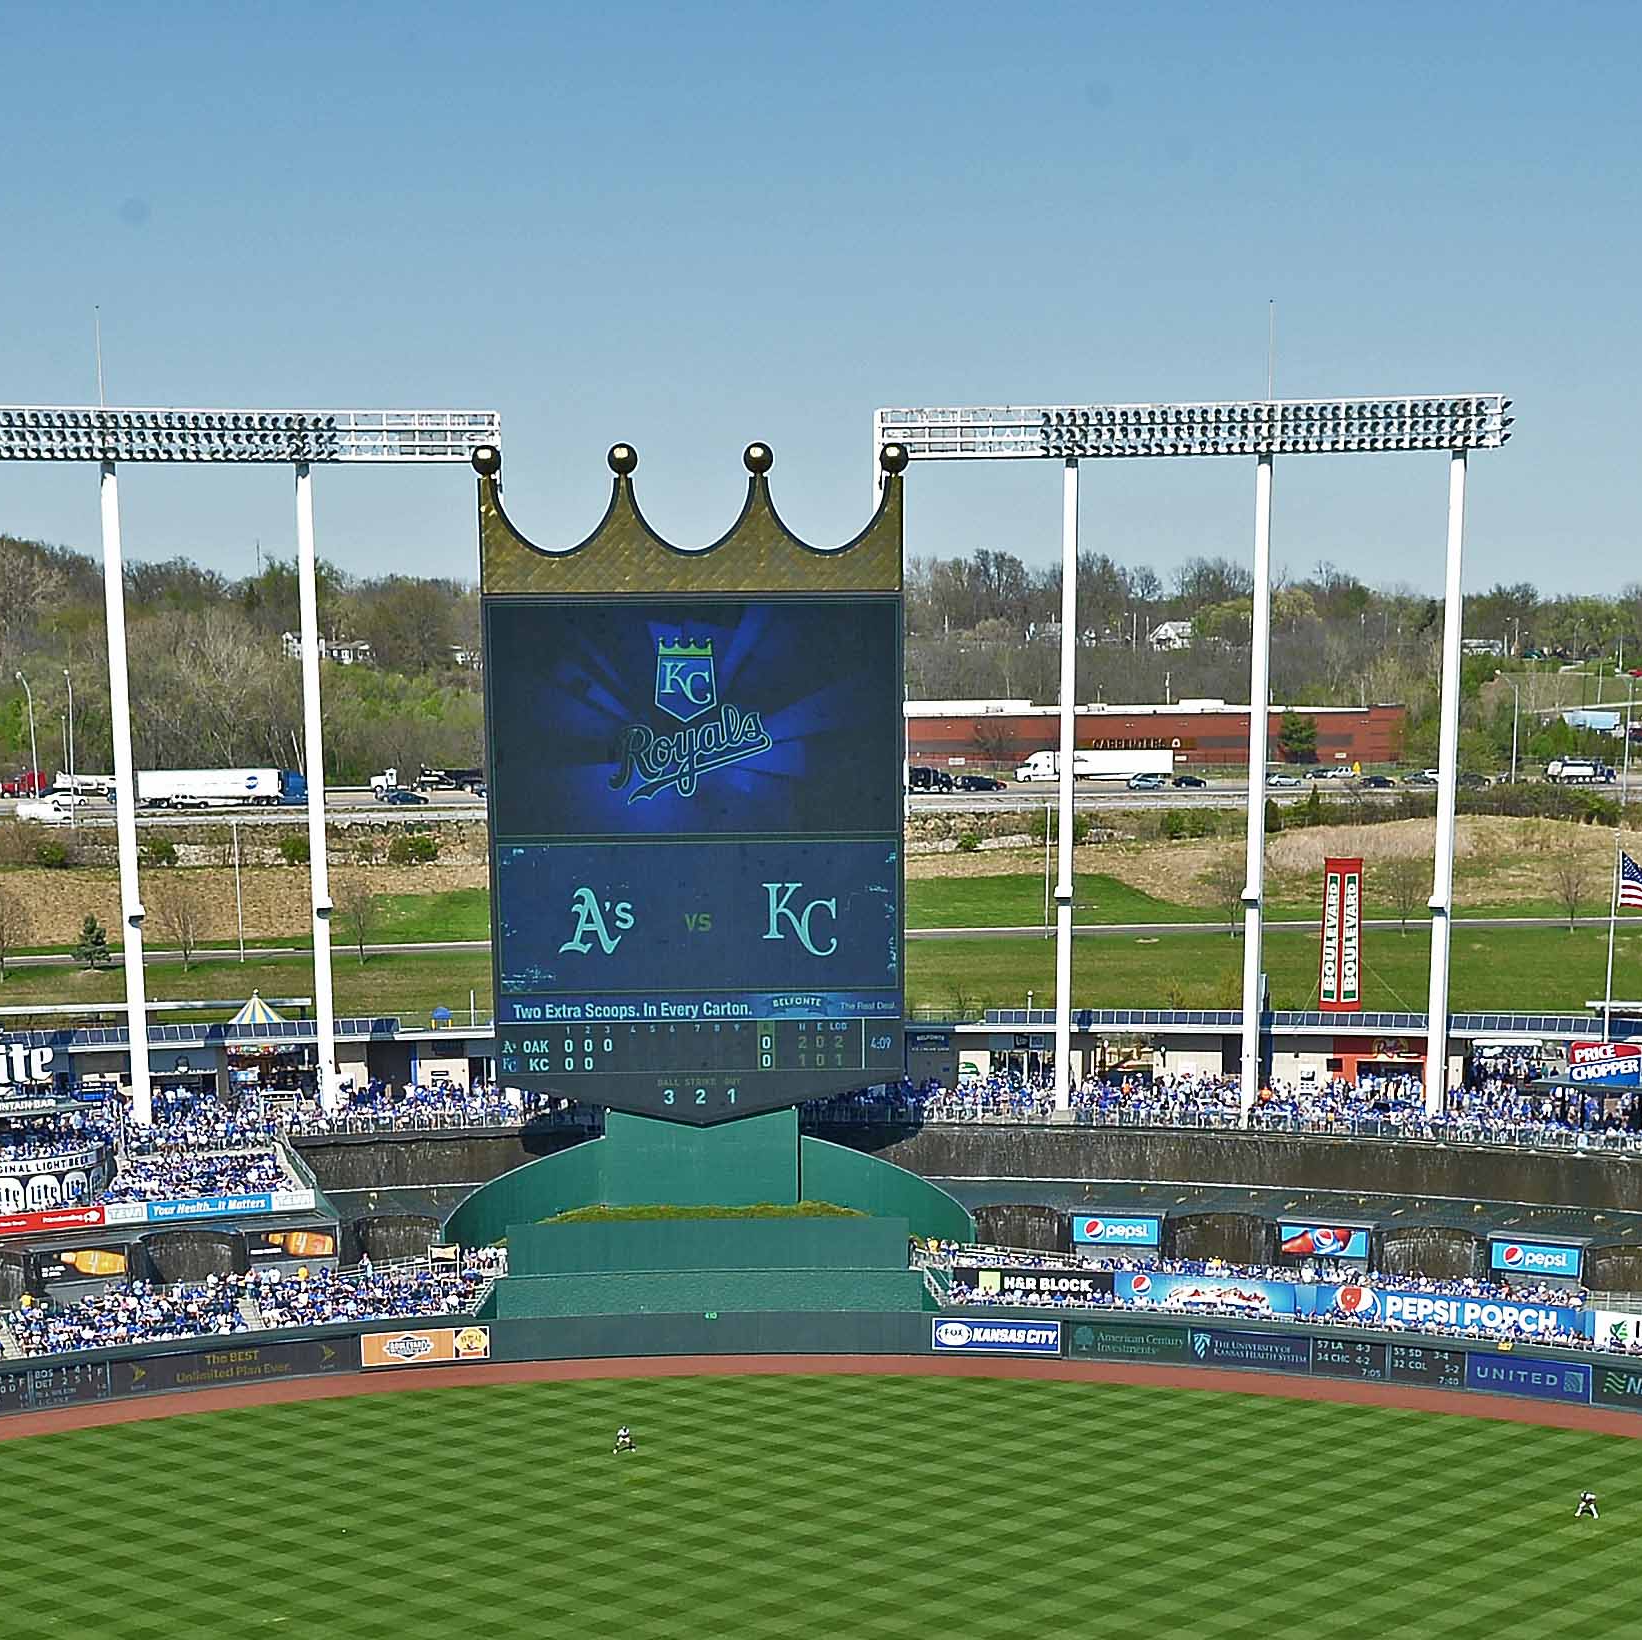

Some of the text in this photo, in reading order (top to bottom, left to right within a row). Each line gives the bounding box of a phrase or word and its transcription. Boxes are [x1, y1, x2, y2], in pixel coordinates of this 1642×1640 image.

[661, 661, 711, 705] KC
[608, 703, 773, 805] Royals
[558, 887, 635, 955] A's
[761, 882, 838, 956] KC
[1323, 883, 1338, 991] BOULEVARD
[1342, 883, 1358, 991] BOULEVARD
[512, 1002, 753, 1020] Two Extra Scoops. In Every Carton.
[772, 997, 822, 1008] BELFONTE
[523, 1036, 771, 1054] OAK 0 0 0 0
[1574, 1045, 1617, 1063] PRICE
[529, 1054, 771, 1071] KC 0 0 0
[1571, 1059, 1640, 1081] CHOPPER
[663, 1087, 737, 1105] 3 2 1
[36, 1159, 67, 1172] LIGHT
[153, 1198, 266, 1217] Your Matters
[1105, 1223, 1149, 1240] pepsi
[1524, 1251, 1568, 1268] pepsi
[1004, 1276, 1093, 1293] H&R BLOCK
[1385, 1293, 1557, 1331] PEPSI PORCH
[943, 1329, 964, 1338] FOX
[972, 1327, 1027, 1345] KANSAS
[1097, 1331, 1184, 1347] American Century
[1097, 1342, 1157, 1355] Investments
[1331, 1341, 1344, 1351] LA
[1408, 1348, 1423, 1358] SD
[204, 1350, 261, 1367] The BEST
[1330, 1354, 1350, 1364] CHC
[1408, 1360, 1428, 1371] COL
[34, 1368, 54, 1380] BOS
[176, 1366, 235, 1386] Unlimited
[235, 1363, 263, 1382] Plan
[1476, 1366, 1559, 1387] UNITED
